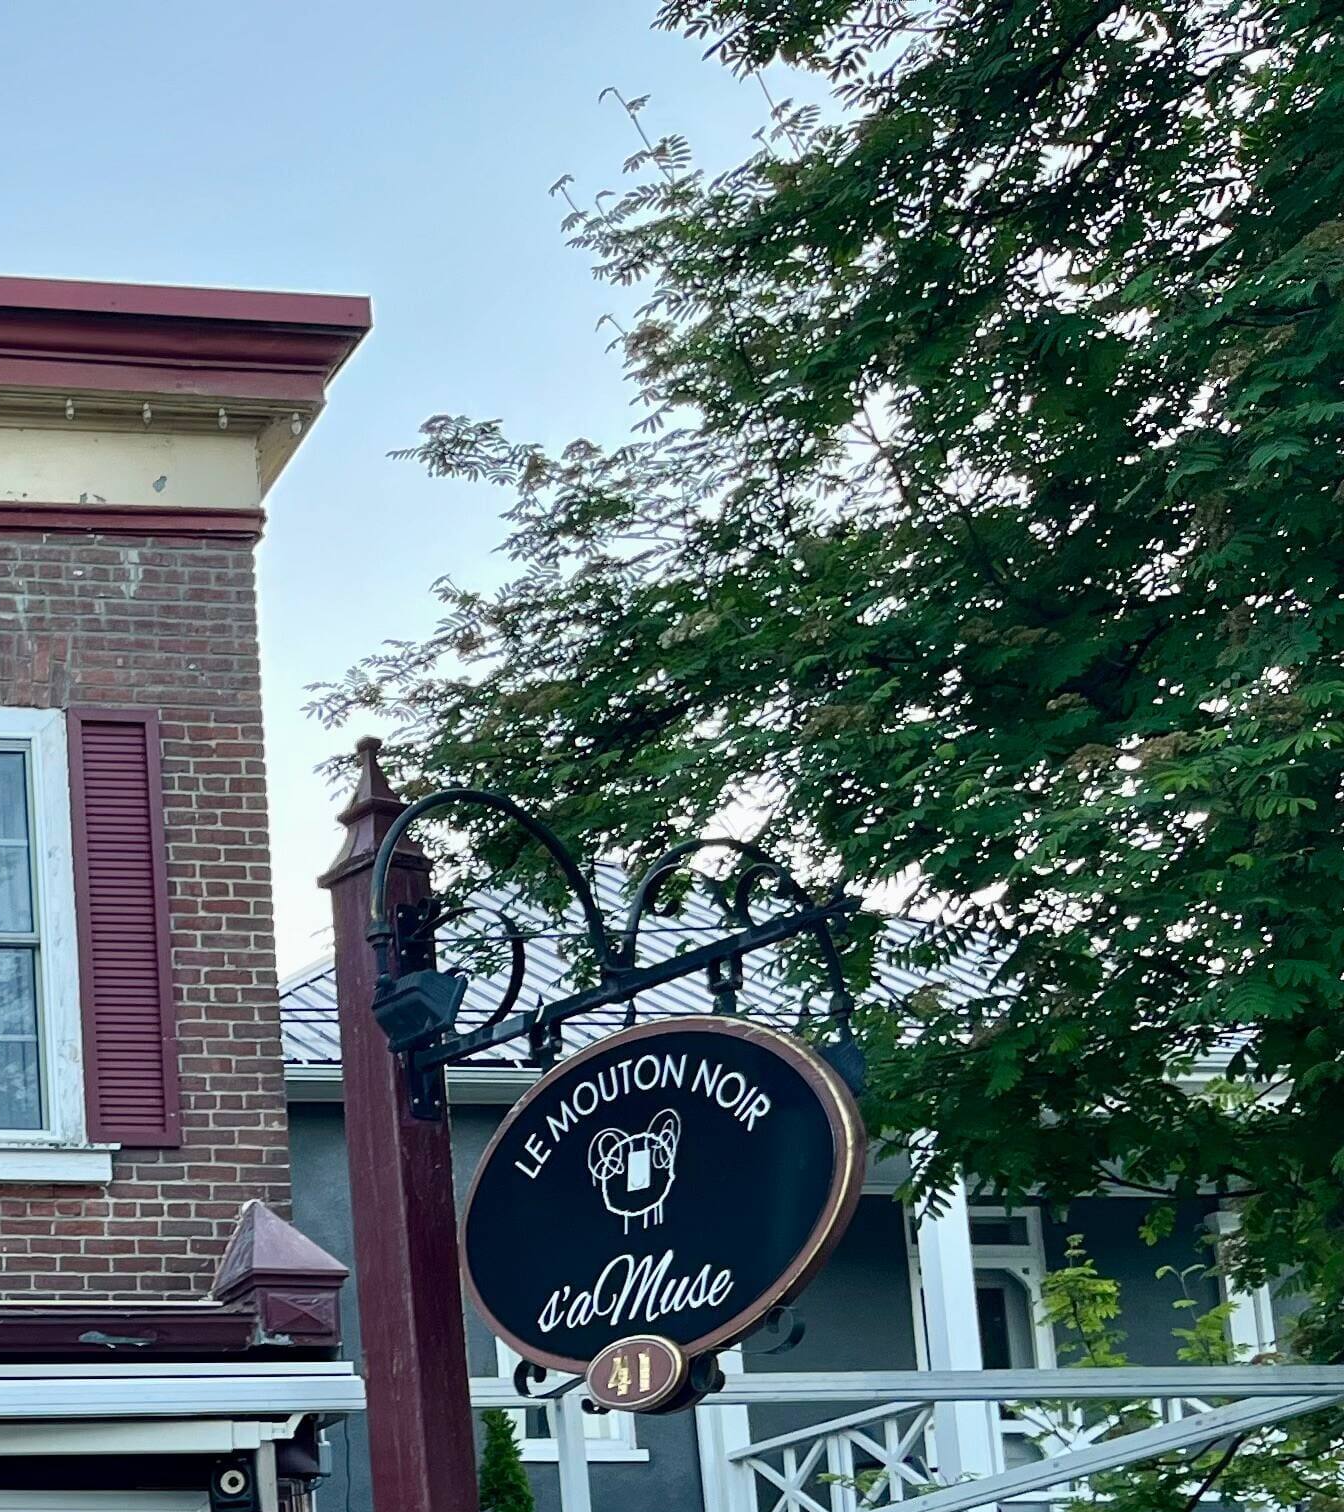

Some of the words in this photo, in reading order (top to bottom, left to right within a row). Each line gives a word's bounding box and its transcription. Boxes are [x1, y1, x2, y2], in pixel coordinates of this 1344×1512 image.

[514, 1132, 552, 1180] LE
[546, 1053, 688, 1143] MOUTON
[690, 1058, 772, 1132] NOIR
[608, 1348, 651, 1397] 41
